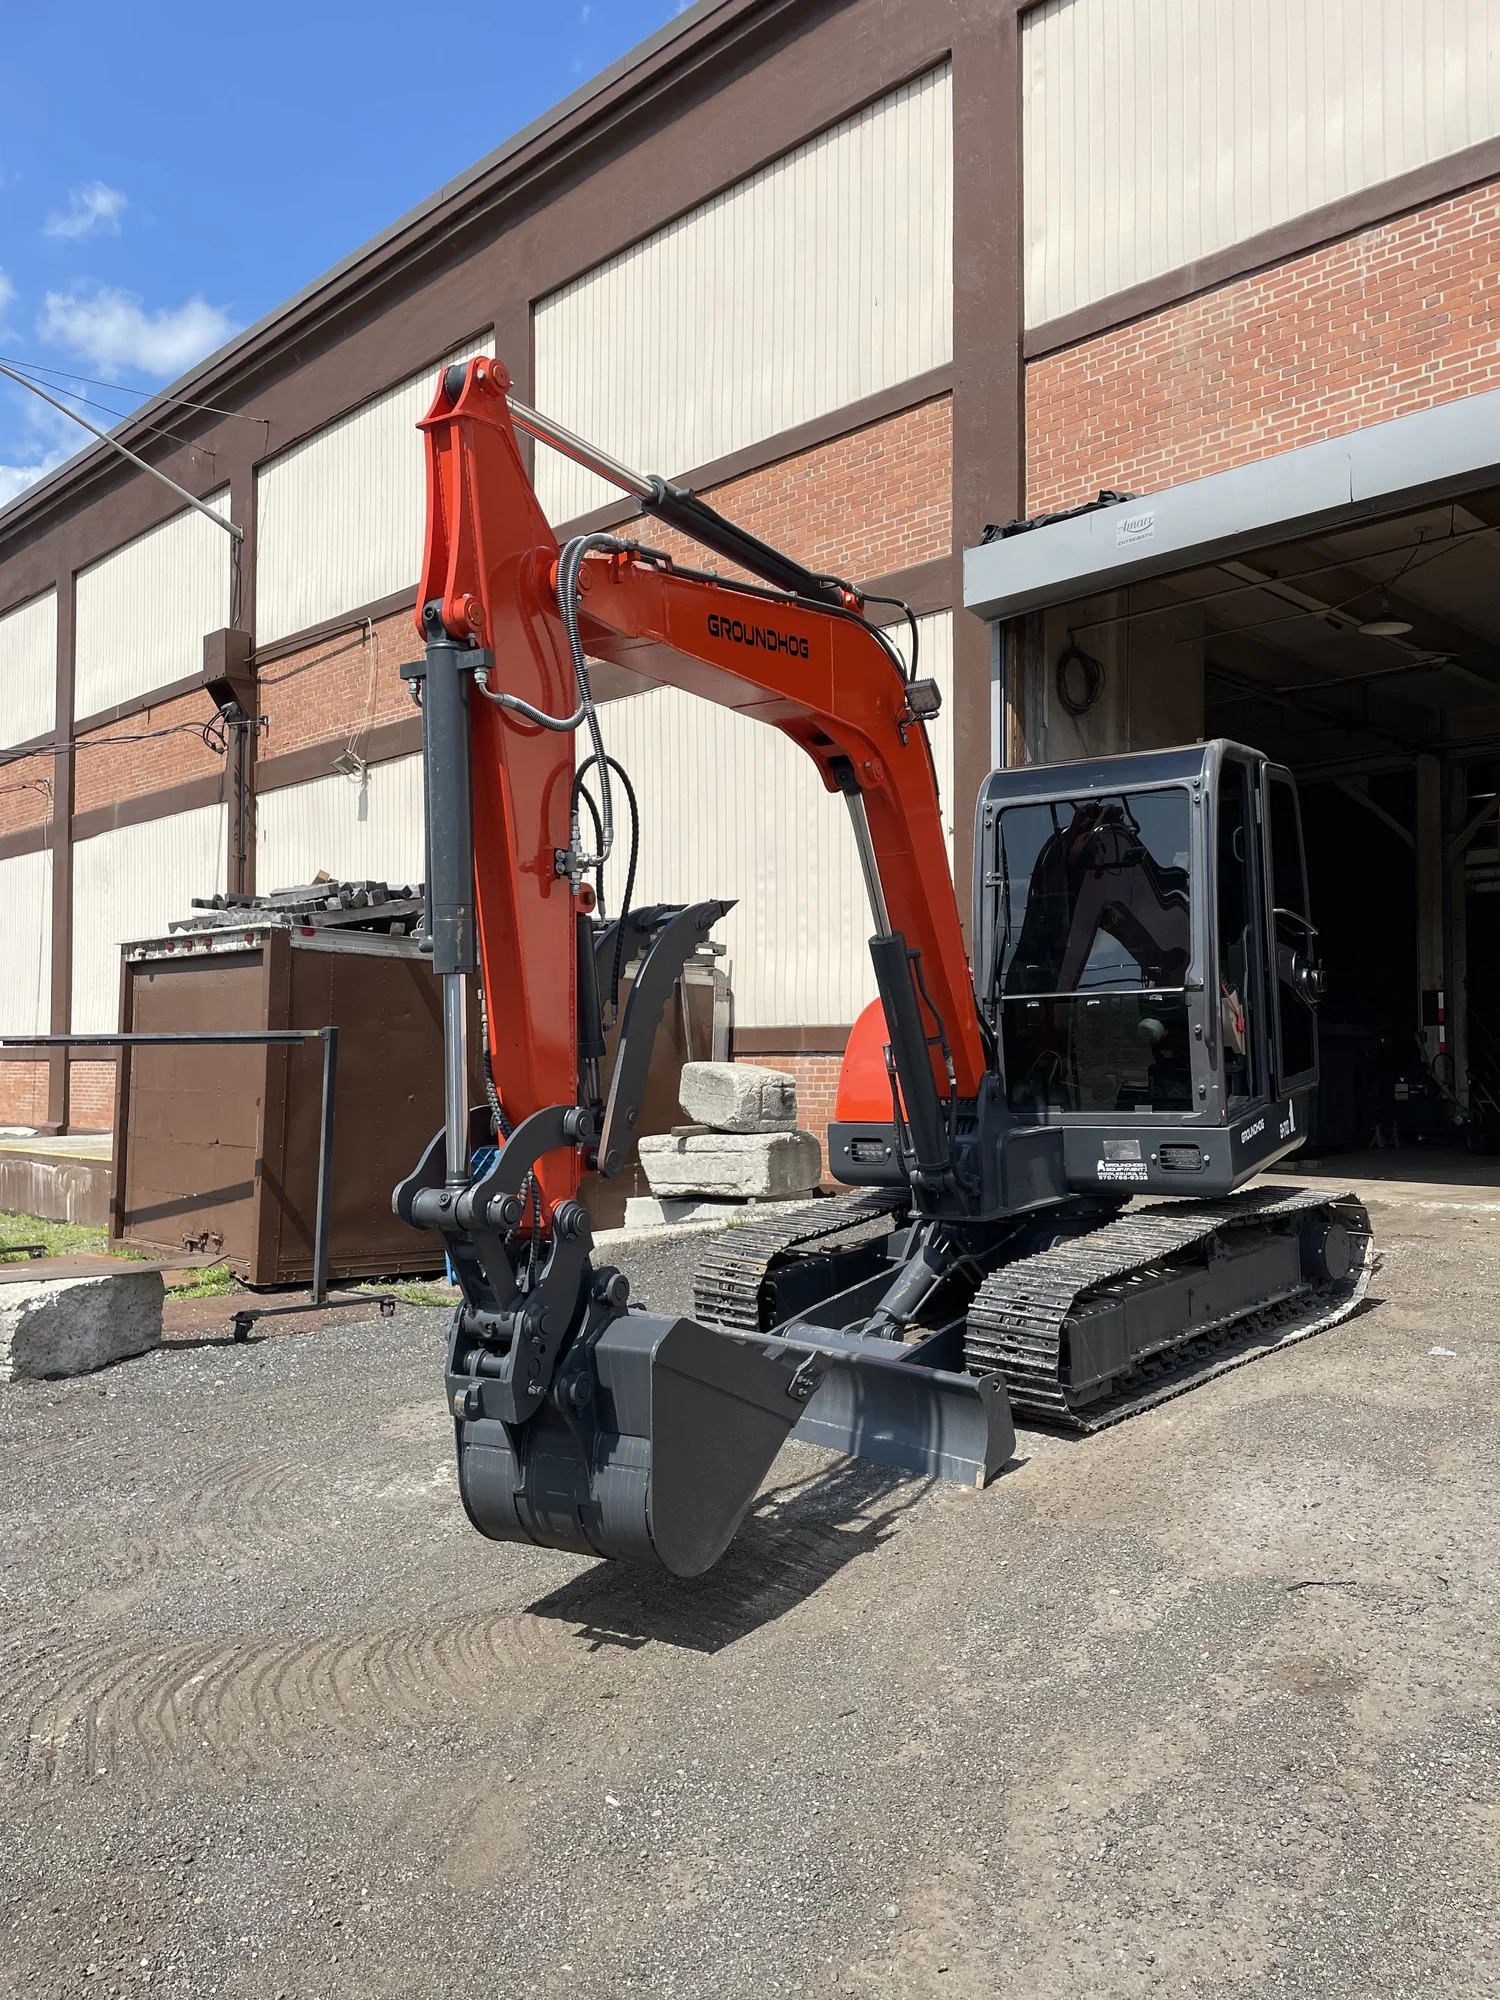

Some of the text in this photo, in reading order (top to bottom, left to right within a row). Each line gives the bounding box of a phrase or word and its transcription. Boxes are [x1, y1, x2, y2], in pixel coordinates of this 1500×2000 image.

[1117, 516, 1154, 534] Amarr
[1118, 532, 1154, 546] ENTREMATIC
[708, 613, 809, 659] GROUNDHOG
[1241, 1118, 1265, 1144] GROUNDHOG
